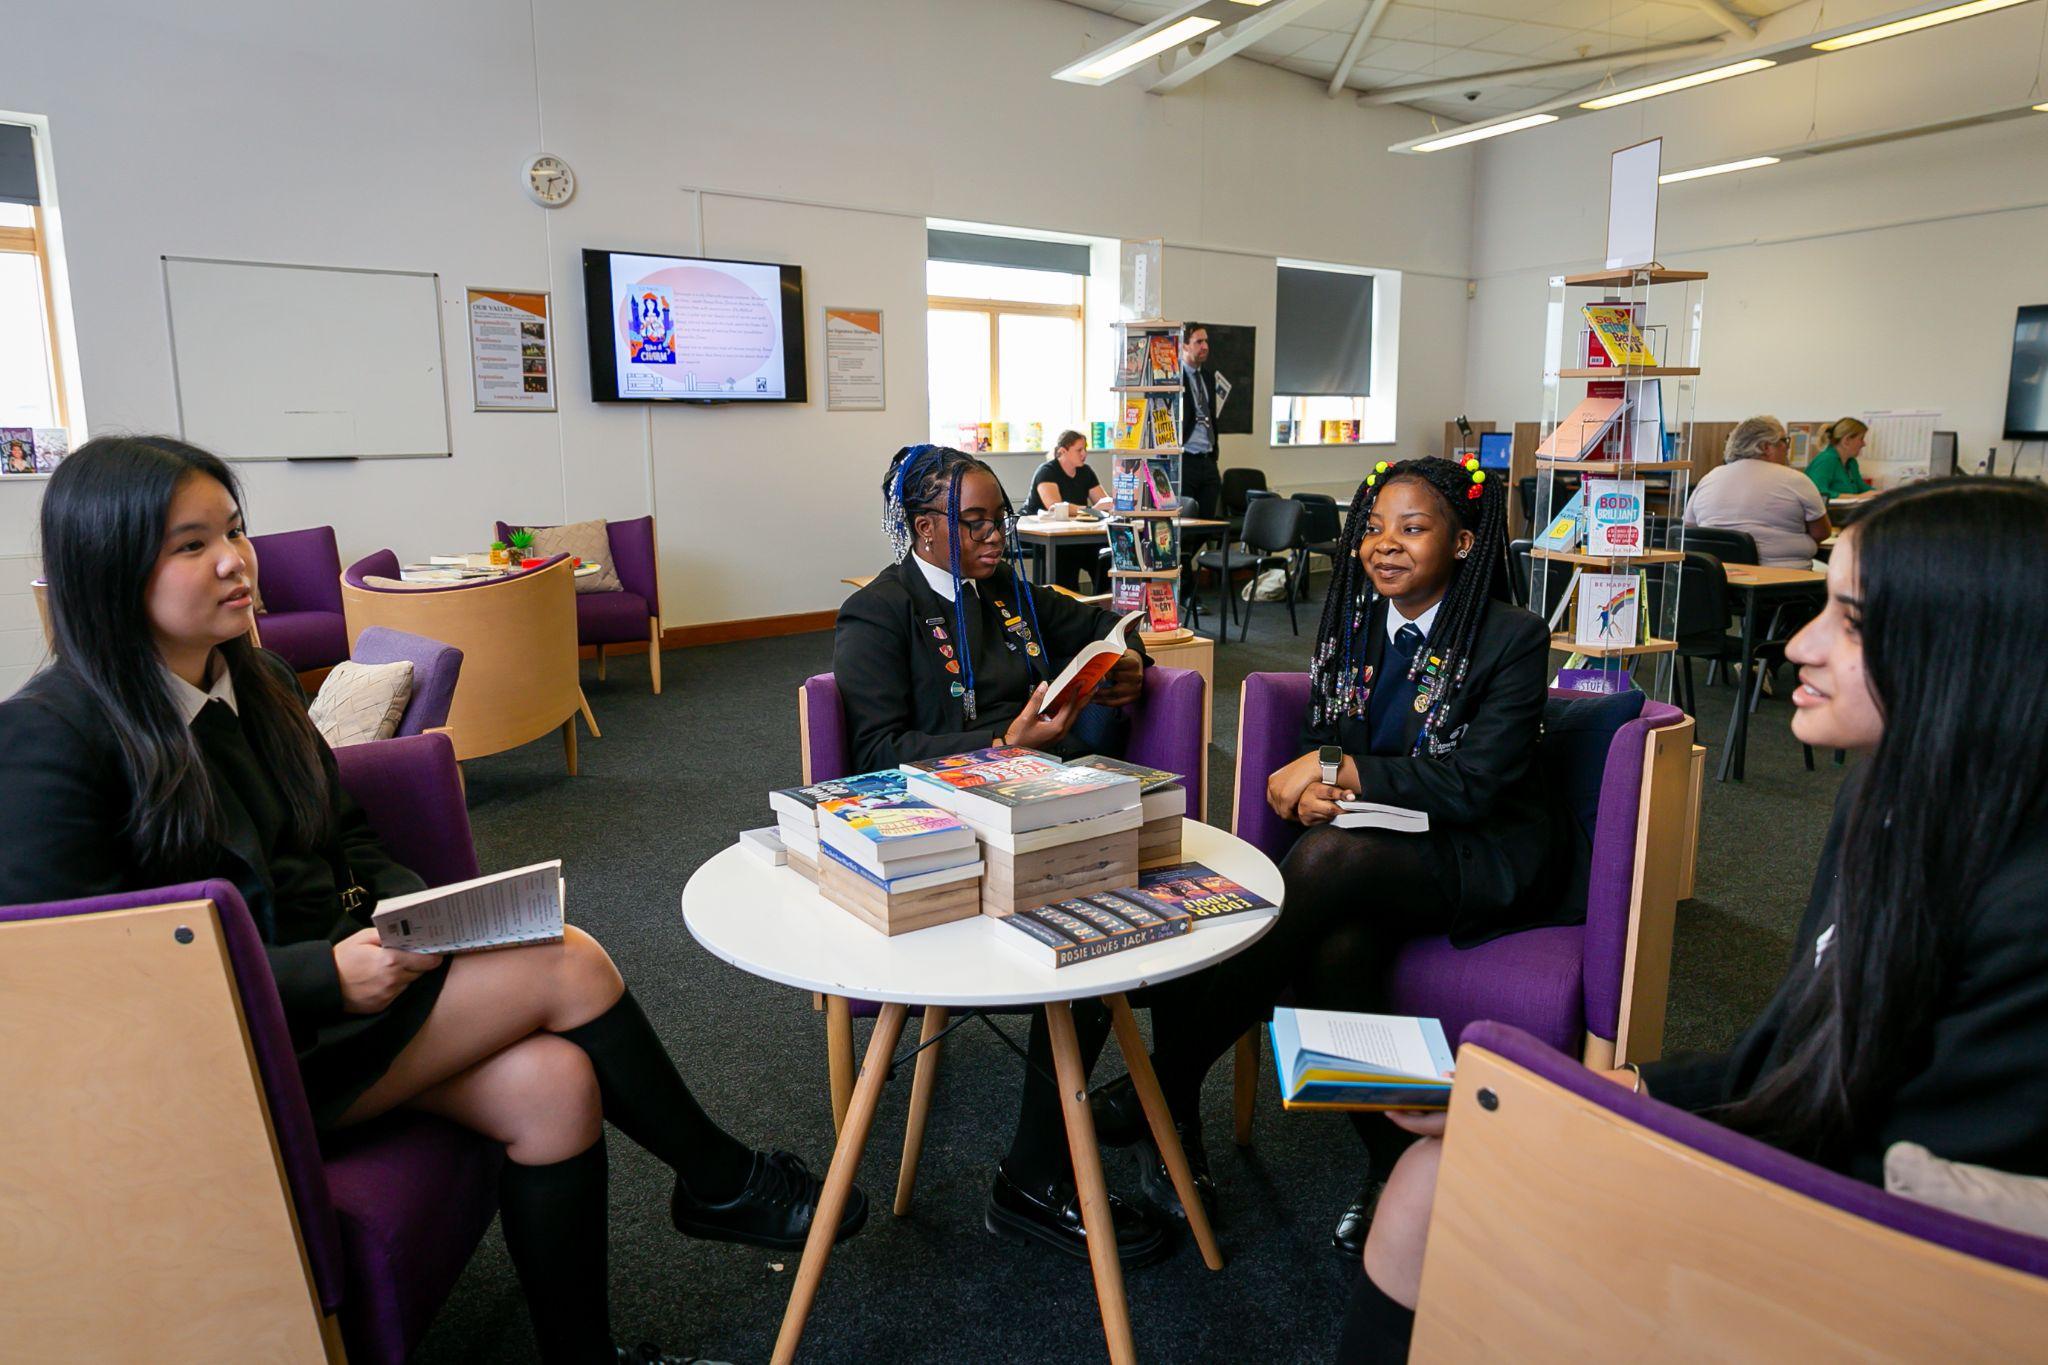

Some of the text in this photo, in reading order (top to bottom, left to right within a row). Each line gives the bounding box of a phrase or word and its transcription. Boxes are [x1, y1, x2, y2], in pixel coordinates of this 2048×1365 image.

[1152, 408, 1168, 423] STAY
[1600, 497, 1633, 509] BODY
[1121, 584, 1140, 592] OVER
[1182, 893, 1232, 911] ADOLF
[1197, 898, 1253, 916] EDGAR
[1060, 931, 1148, 964] ROSIE LOVES JACK
